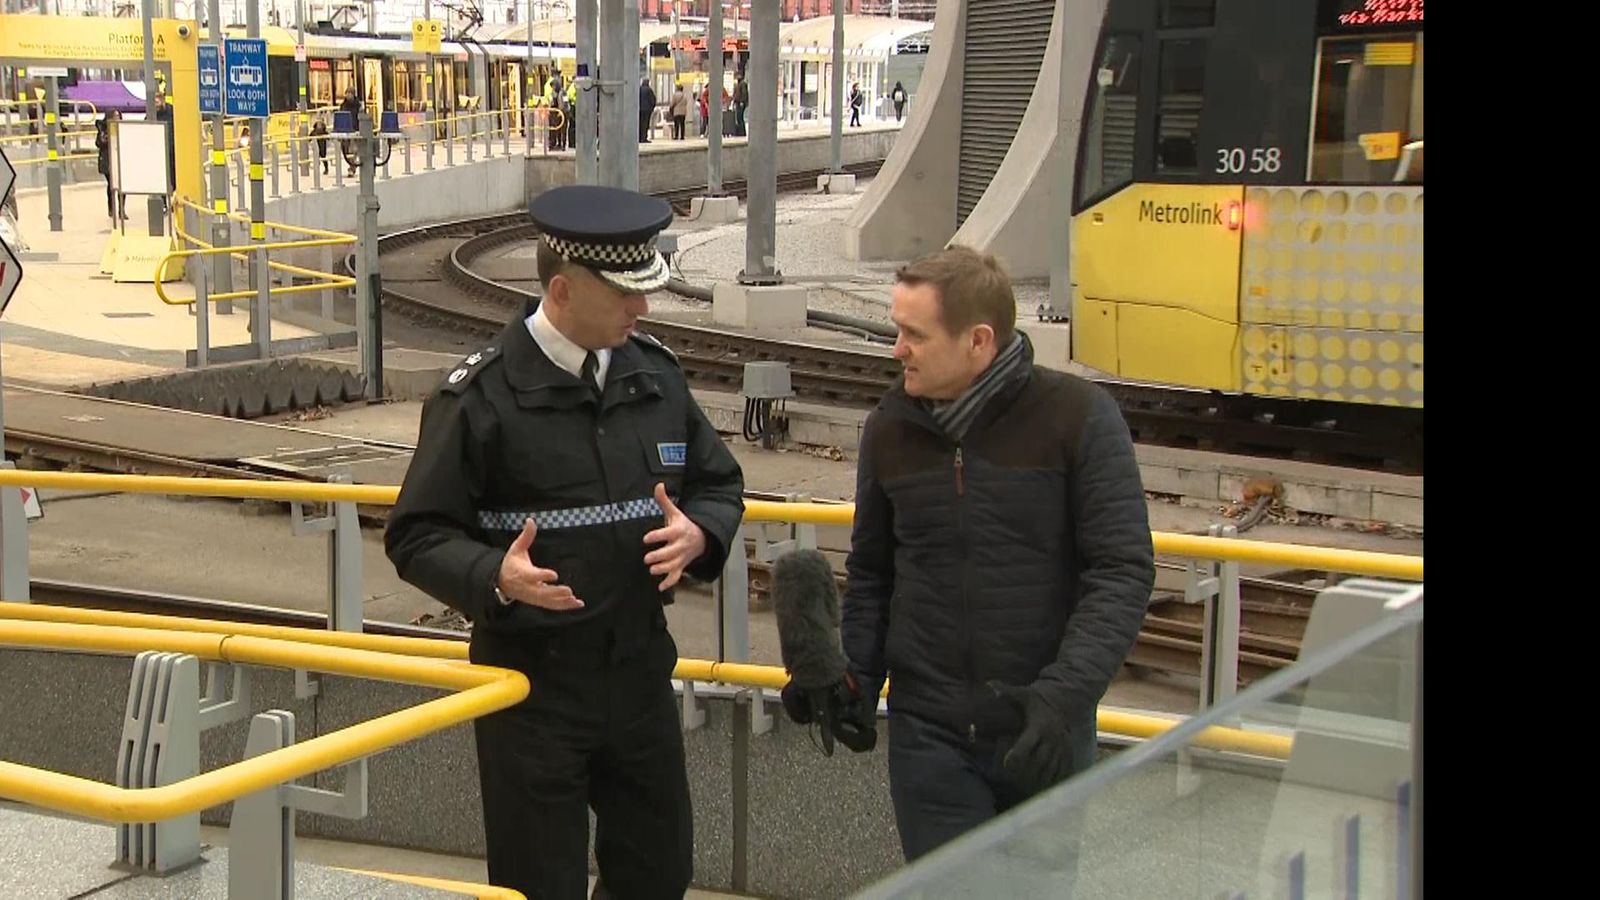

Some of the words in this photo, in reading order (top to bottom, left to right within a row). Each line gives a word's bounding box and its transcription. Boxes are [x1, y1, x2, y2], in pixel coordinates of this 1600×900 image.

[108, 32, 154, 45] Platfor
[156, 34, 165, 44] A
[229, 42, 262, 54] TRAMWAY
[227, 88, 247, 99] LOOK
[247, 89, 266, 101] BOTH
[237, 101, 257, 112] WAYS
[1215, 148, 1245, 174] 30
[1249, 147, 1281, 173] 58
[1138, 200, 1223, 225] Metrolink
